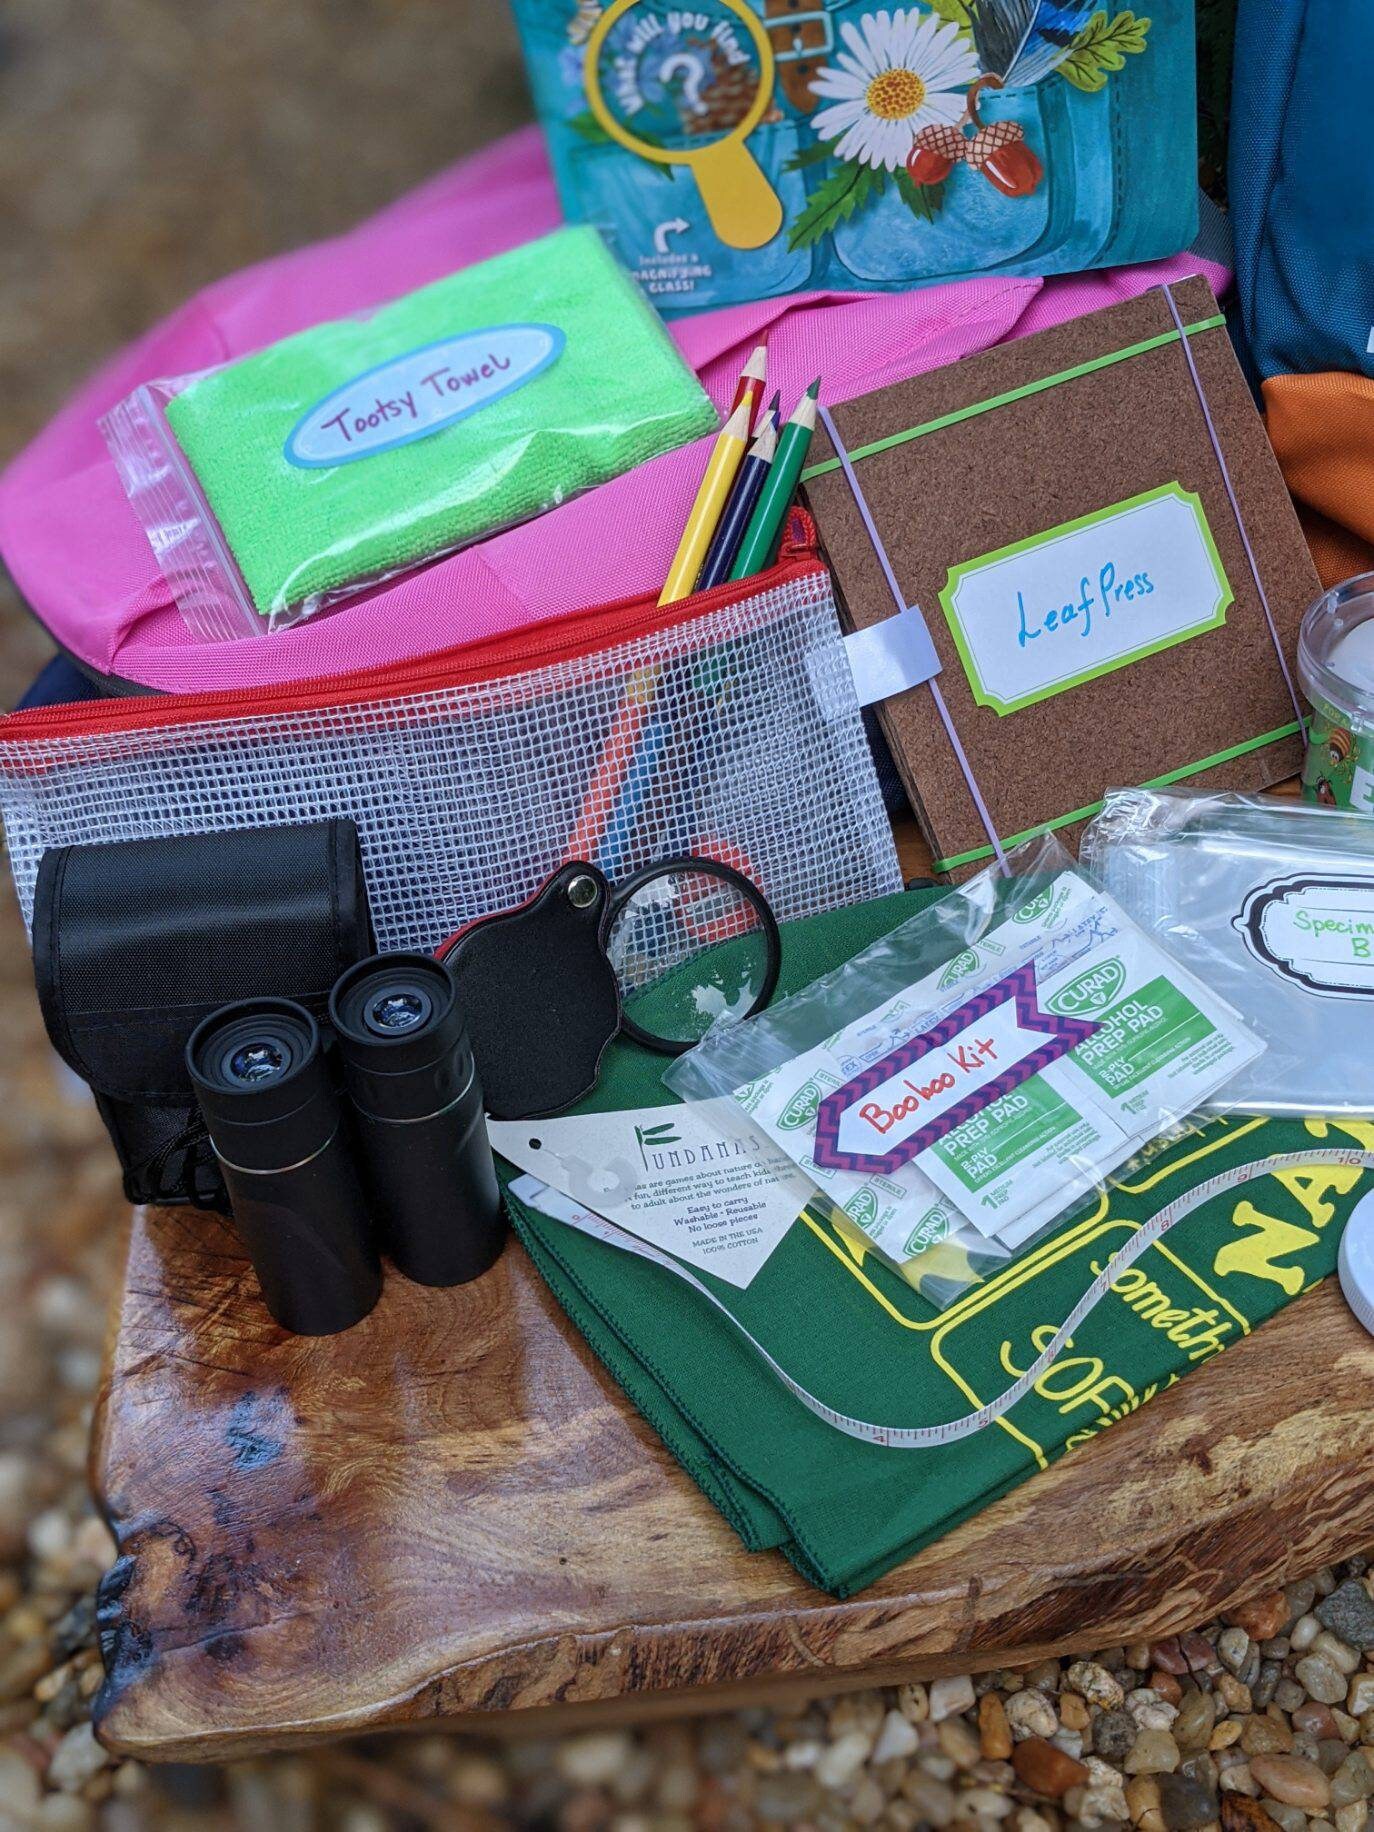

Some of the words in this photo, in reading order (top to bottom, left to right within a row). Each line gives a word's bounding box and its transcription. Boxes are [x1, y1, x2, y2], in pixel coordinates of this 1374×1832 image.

[667, 12, 709, 34] you
[321, 391, 417, 441] Tootsy
[420, 354, 510, 396] Towel
[1017, 577, 1094, 647] Leaf
[1100, 562, 1154, 617] Press
[1057, 966, 1118, 1011] CURAD
[1074, 999, 1148, 1056] ALCOHOL
[1081, 1030, 1126, 1066] PREP
[1127, 1005, 1164, 1033] PAD
[946, 1038, 998, 1074] Kit
[1098, 1056, 1126, 1079] 2-PLY
[1104, 1063, 1135, 1086] PAD
[783, 1085, 818, 1126] CURAD
[943, 1119, 990, 1157] PREP
[991, 1094, 1028, 1124] PAD
[960, 1147, 989, 1169] 2-PLY
[965, 1154, 998, 1180] PAD
[1338, 1155, 1362, 1166] 10
[648, 1180, 663, 1188] are
[665, 1174, 694, 1187] games
[695, 1168, 721, 1179] about
[723, 1162, 751, 1174] nature
[651, 1183, 691, 1197] different
[692, 1180, 713, 1191] way
[726, 1171, 750, 1182] teach
[1236, 1173, 1248, 1184] 9
[630, 1202, 641, 1210] to
[643, 1197, 665, 1208] adult
[668, 1192, 694, 1203] about
[695, 1188, 711, 1198] the
[713, 1181, 751, 1194] wonders
[753, 1178, 763, 1186] of
[687, 1203, 710, 1215] Easy
[723, 1196, 748, 1208] carry
[673, 1211, 718, 1226] Washable
[725, 1200, 766, 1215] Reusable
[688, 1223, 702, 1233] No
[703, 1218, 728, 1229] loose
[729, 1212, 758, 1226] pieces
[1160, 1219, 1170, 1232] 8
[691, 1236, 717, 1246] MADE
[729, 1230, 743, 1239] THE
[745, 1226, 763, 1236] USA
[702, 1244, 725, 1253] 100%
[726, 1237, 758, 1248] COTTON
